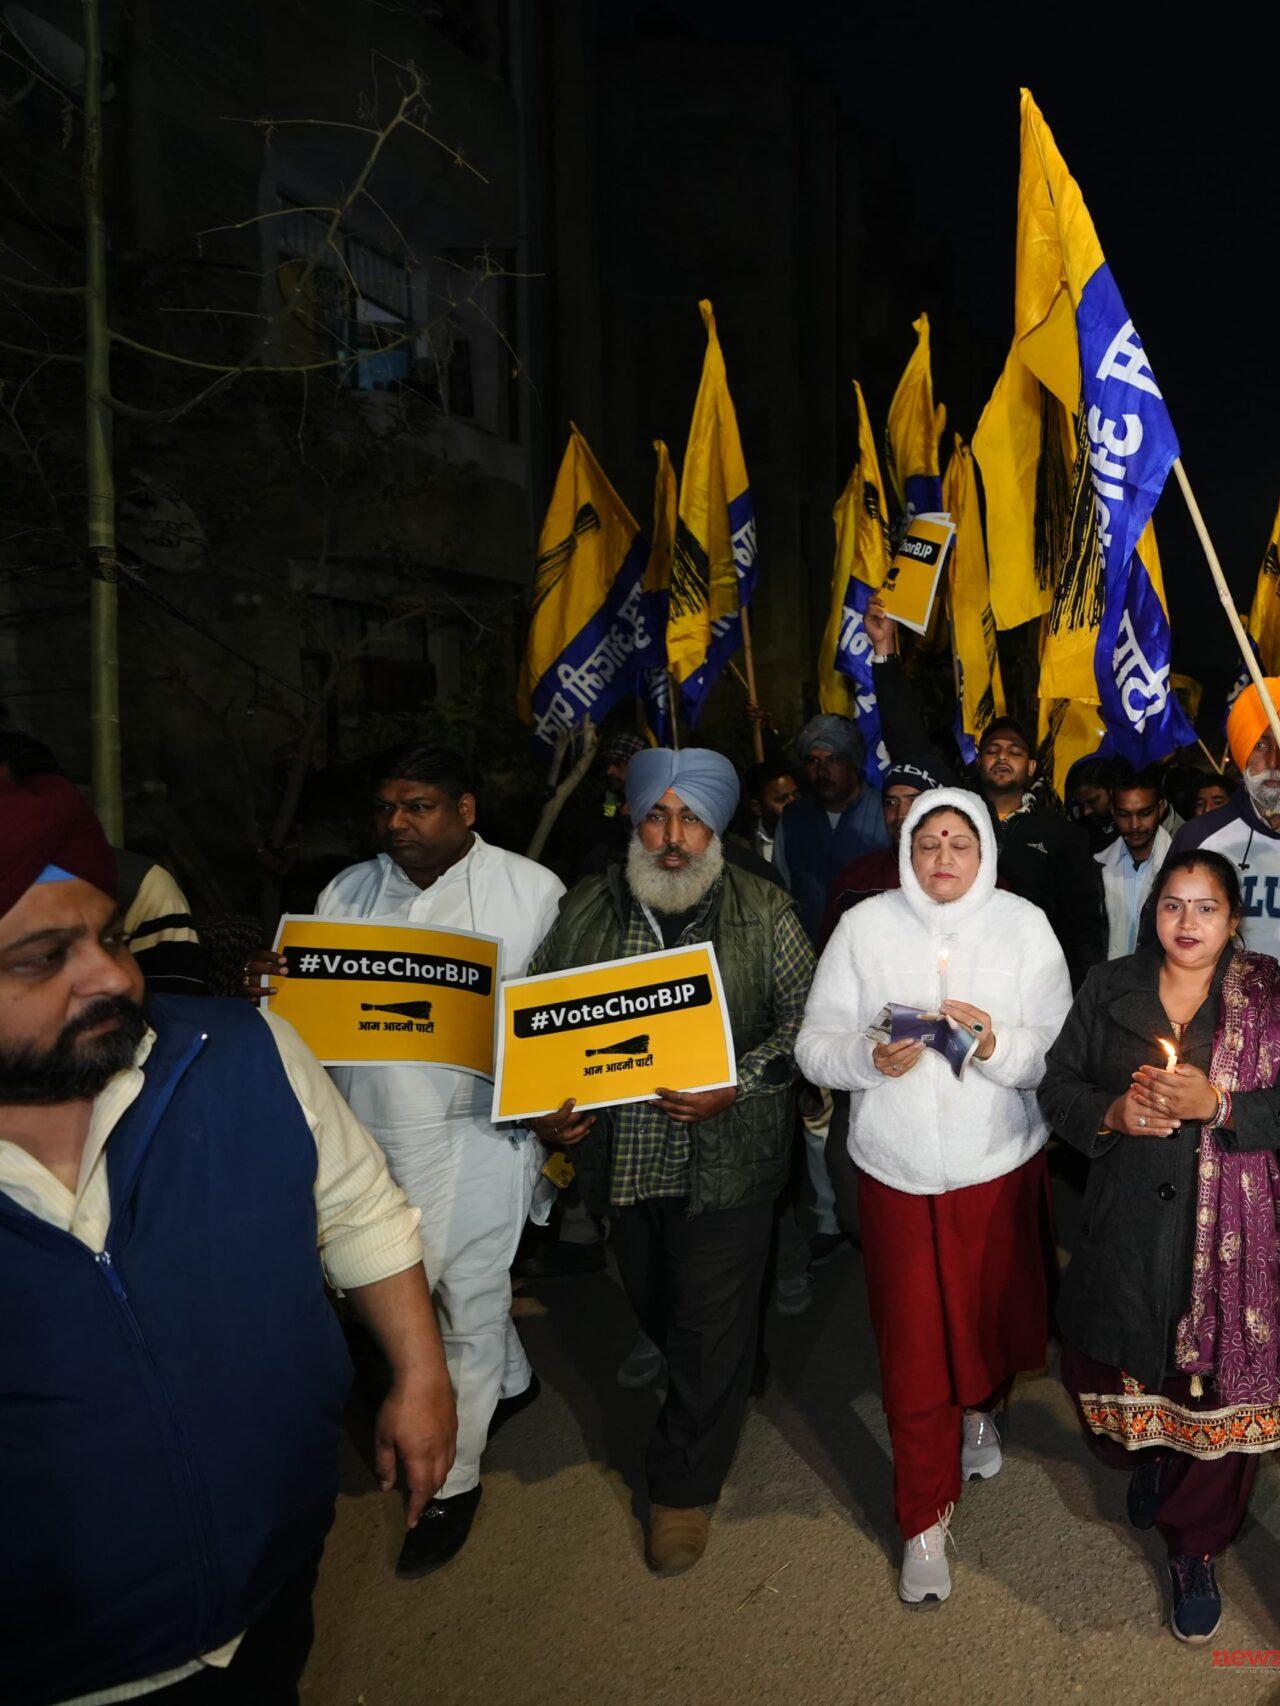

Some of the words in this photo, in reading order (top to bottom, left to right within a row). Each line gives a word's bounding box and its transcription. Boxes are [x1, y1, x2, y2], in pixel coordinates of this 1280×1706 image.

[300, 954, 479, 985] #VoteChorBJP
[531, 984, 696, 1031] #VoteChorBJP
[358, 1021, 381, 1031] आम
[383, 1020, 413, 1032] आदमी
[416, 1022, 434, 1033] पार्टी
[583, 1065, 603, 1076] आम
[606, 1058, 634, 1073] आदमी
[636, 1054, 654, 1068] पार्टी
